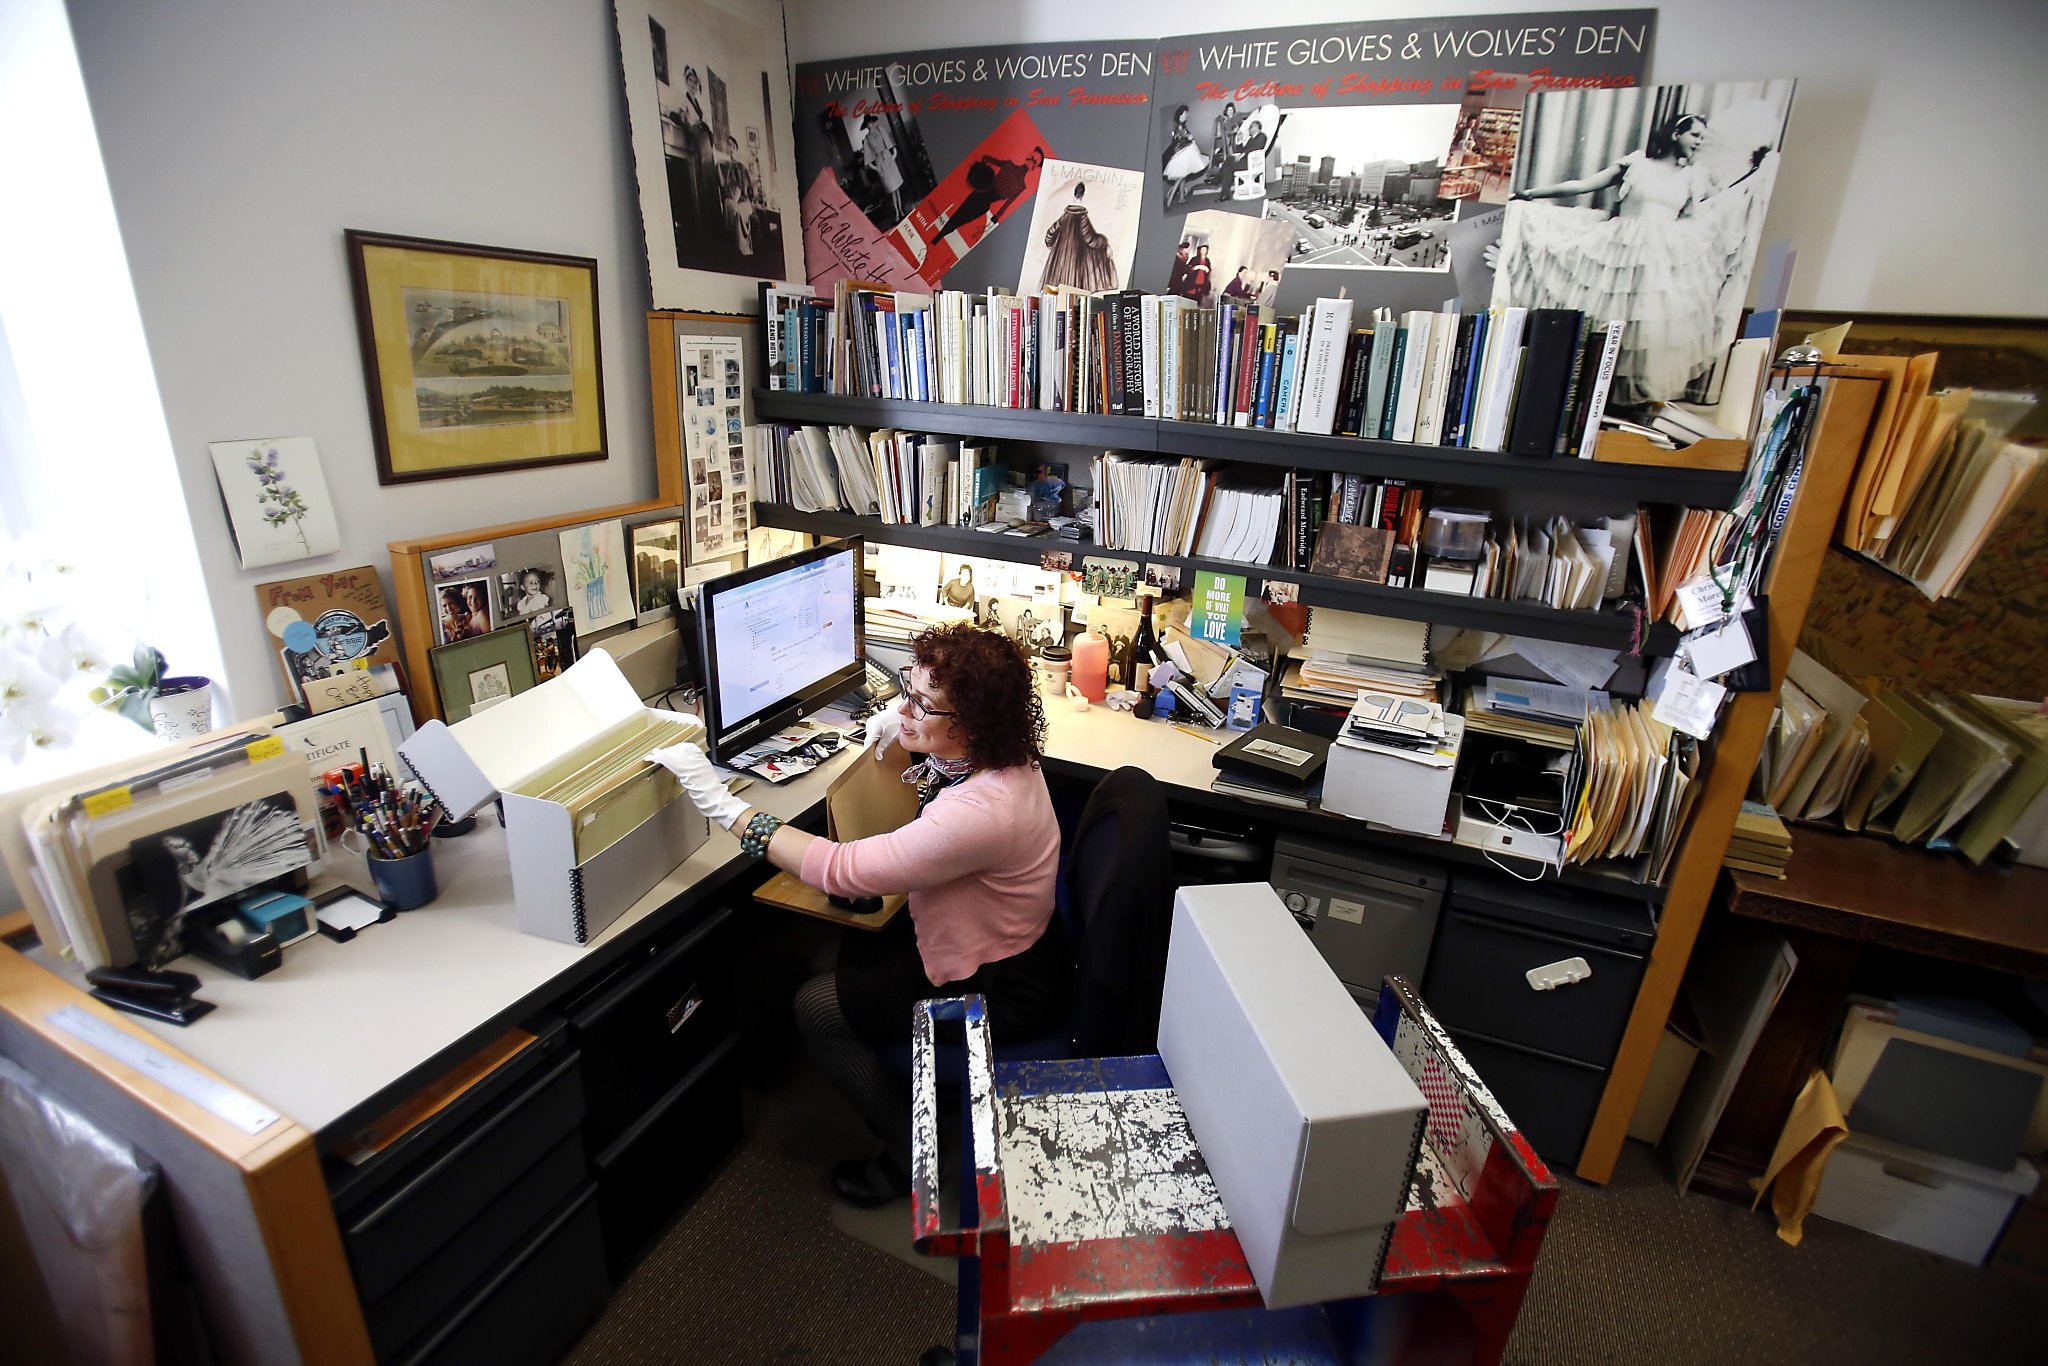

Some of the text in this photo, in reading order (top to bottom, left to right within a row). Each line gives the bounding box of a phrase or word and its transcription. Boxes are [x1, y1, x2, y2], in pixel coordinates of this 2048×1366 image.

[1200, 41, 1279, 71] WHITE
[1287, 34, 1392, 66] GLOVES
[1402, 32, 1422, 60] &
[1575, 25, 1646, 55] DEN
[826, 66, 883, 92] WHITE
[889, 59, 966, 86] GLOVES
[972, 58, 988, 81] &
[1101, 52, 1152, 77] DEN
[1196, 67, 1634, 101] The Culture of Shopping in San Francisco
[824, 87, 1147, 118] The Culture of Shopping in San Francisco
[1060, 166, 1124, 186] MAGNIN
[810, 198, 839, 242] The
[831, 222, 871, 272] White
[1123, 306, 1132, 320] OF
[1324, 312, 1335, 333] RIT
[769, 320, 777, 341] GRAND
[1132, 314, 1141, 350] WORLD
[1610, 324, 1622, 345] YEAR
[1113, 330, 1123, 392] DANGEROUS
[1124, 322, 1134, 394] PHOTOGRAPHY
[1315, 353, 1324, 377] DIGITAL
[1354, 349, 1363, 370] Cataloging
[1570, 348, 1585, 381] INSIDE
[1601, 356, 1614, 381] FOCUS
[1133, 352, 1142, 394] HISTORY
[1314, 340, 1331, 419] PRESERVING PHOTOGRAPHS
[1251, 379, 1259, 403] Photography
[1279, 379, 1289, 414] CAMERA
[1312, 377, 1320, 398] WORLD
[1349, 377, 1359, 402] Classification
[1565, 383, 1578, 412] MUNI
[1344, 478, 1358, 524] SUBVERSIVES
[1382, 486, 1400, 519] DOUBLE
[1298, 487, 1308, 556] Eadweard Muybridge
[1769, 491, 1793, 543] RECORDS
[1206, 589, 1231, 603] MORE
[1214, 576, 1226, 591] DO
[1205, 600, 1230, 614] OF WHAT
[1206, 611, 1227, 622] YOU
[346, 636, 363, 645] BRIE
[1203, 619, 1227, 641] LOVE
